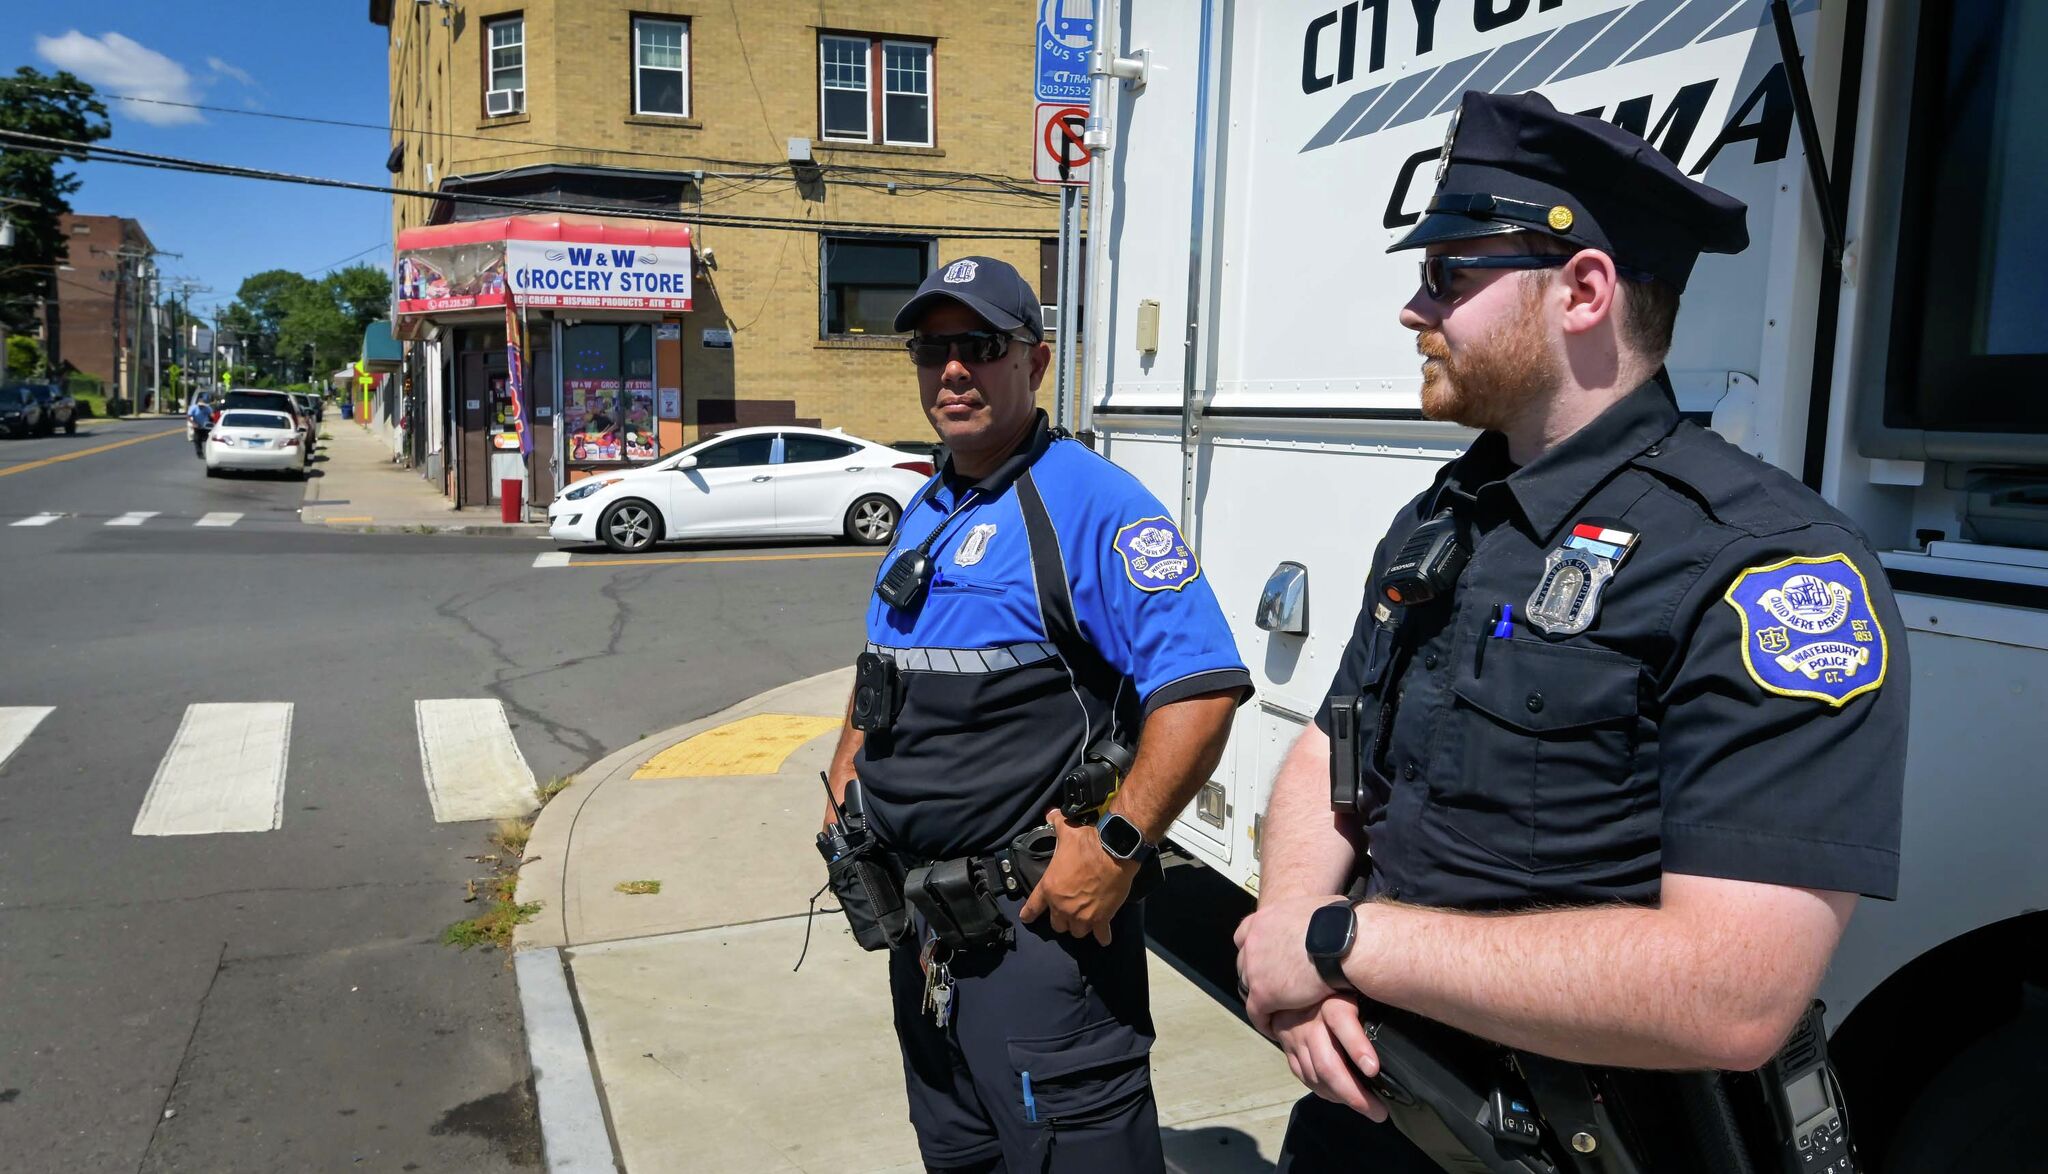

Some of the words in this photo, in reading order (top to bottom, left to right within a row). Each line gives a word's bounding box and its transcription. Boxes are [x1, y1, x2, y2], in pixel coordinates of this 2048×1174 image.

[1043, 39, 1069, 61] BUS
[1302, 0, 1441, 95] CITY
[568, 247, 592, 267] W
[595, 253, 608, 267] &
[611, 249, 635, 268] W
[516, 268, 613, 291] GROCERY
[620, 272, 684, 294] STORE
[529, 295, 557, 305] CREAM
[563, 296, 600, 306] HISPANIC
[602, 297, 643, 307] PRODUCTS
[649, 298, 665, 308] ATM
[671, 299, 686, 309] EBT
[1575, 560, 1591, 575] CITY
[1573, 580, 1591, 612] POLICE
[1771, 596, 1790, 618] QUID
[1787, 614, 1815, 631] AERE
[1851, 619, 1868, 631] EST
[1791, 644, 1859, 664] WATERBURY
[1808, 656, 1848, 671] POLICE
[1824, 671, 1843, 684] CT.
